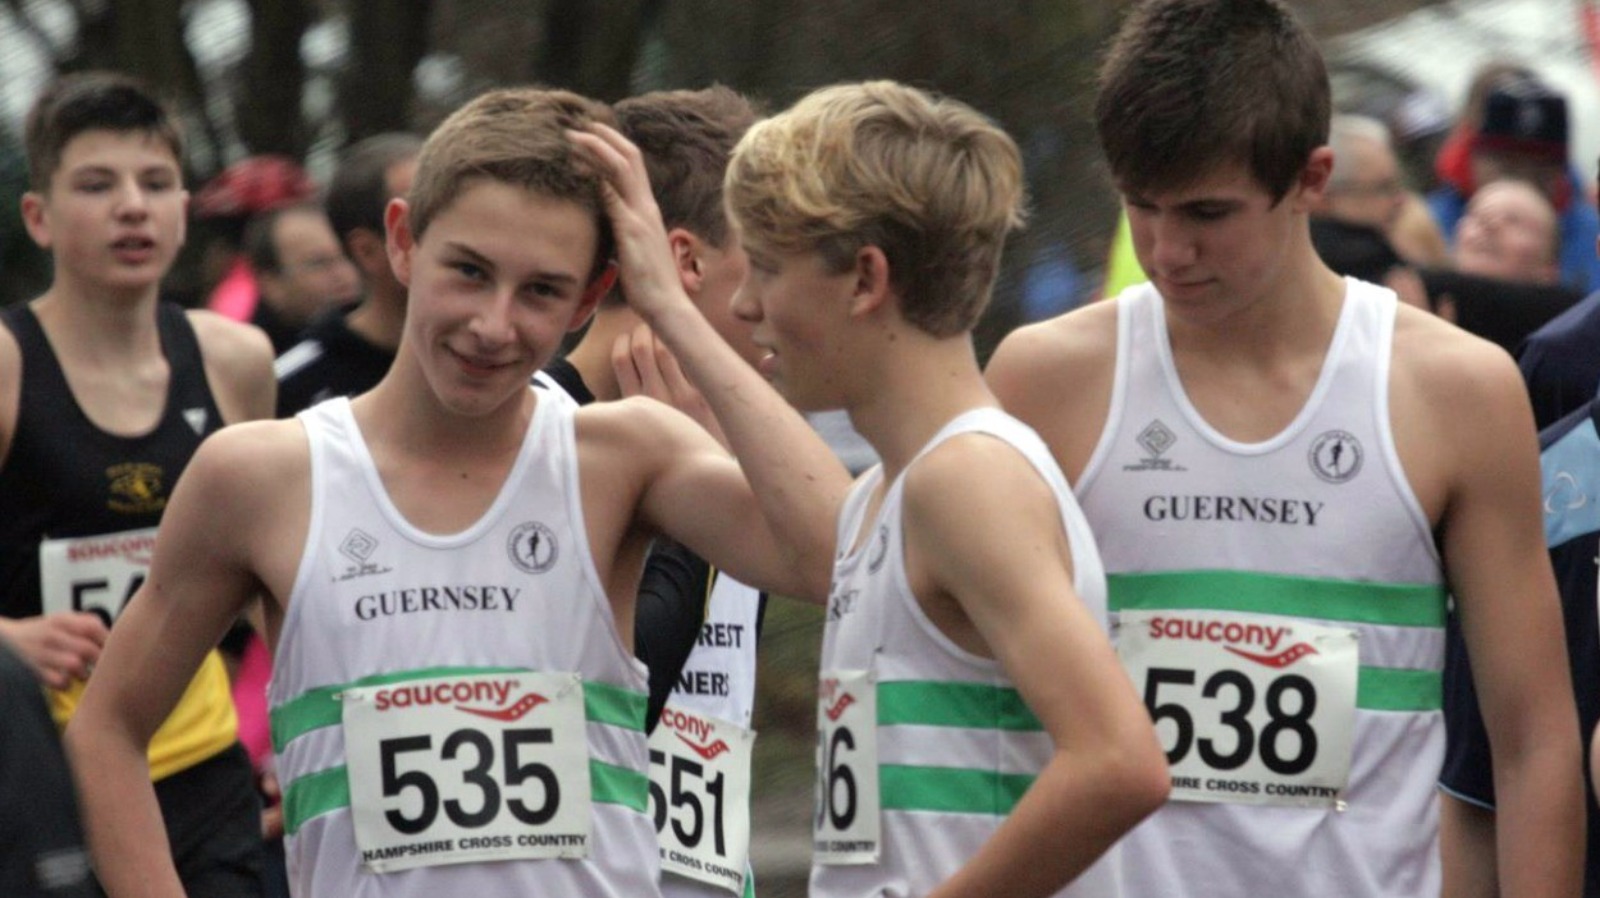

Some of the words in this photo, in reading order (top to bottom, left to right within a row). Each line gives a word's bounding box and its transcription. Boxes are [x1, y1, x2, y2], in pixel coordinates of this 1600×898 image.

[1143, 495, 1325, 526] GUERNSEY
[354, 585, 522, 621] GUERNSEY
[1149, 616, 1284, 651] saucony
[375, 679, 514, 711] saucony
[1144, 667, 1318, 776] 538
[378, 727, 561, 835] 535
[1206, 778, 1260, 794] CROSS
[1265, 783, 1339, 798] COUNTRY
[362, 839, 455, 862] HAMPSHIRE
[459, 835, 513, 850] CROSS
[517, 834, 588, 847] COUNTRY
[670, 850, 702, 869] CROSS
